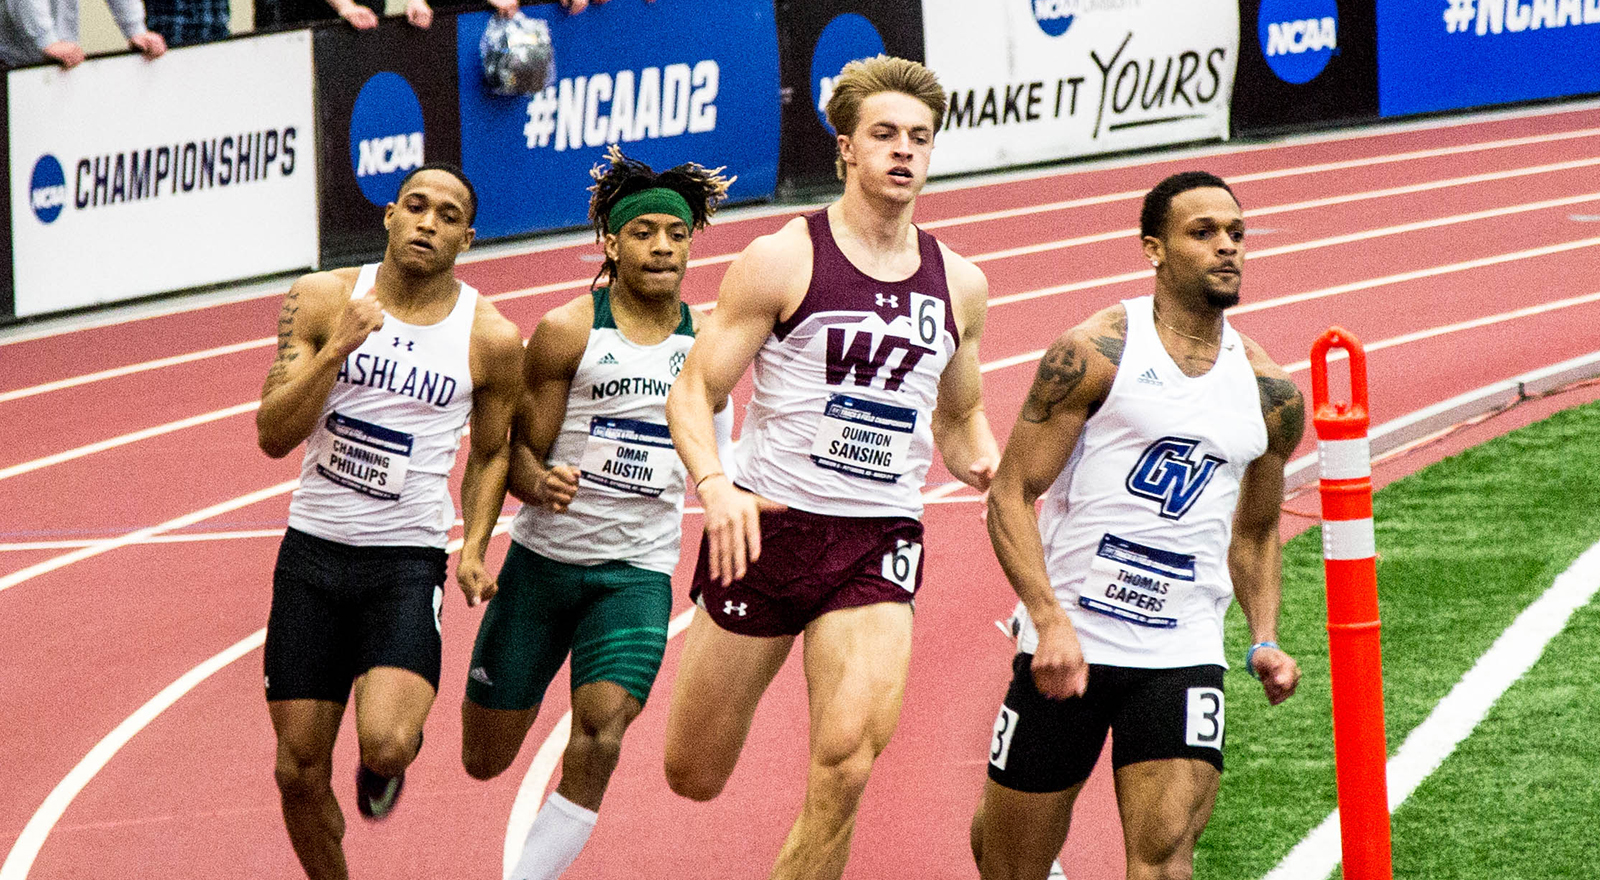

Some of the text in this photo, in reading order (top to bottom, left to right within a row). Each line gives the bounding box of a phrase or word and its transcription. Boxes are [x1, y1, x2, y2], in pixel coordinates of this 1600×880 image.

[1266, 17, 1338, 56] NCAA
[945, 31, 1226, 139] MAKE IT YOURS
[524, 60, 720, 151] #NCAAD2
[75, 127, 297, 210] CHAMPIONSHIPS
[357, 131, 425, 177] NCAA
[918, 298, 937, 345] 6
[336, 353, 457, 407] ASHLAND
[591, 377, 672, 400] NORTHW
[333, 440, 391, 469] CHANNING
[616, 446, 649, 462] OMAR
[829, 440, 893, 468] SANSING
[841, 426, 892, 448] QUINTON
[329, 454, 388, 486] PHILLIPS
[602, 460, 653, 482] AUSTIN
[1125, 435, 1229, 521] GV
[891, 541, 913, 583] 6
[1104, 583, 1166, 613] CAPERS
[1116, 569, 1170, 596] THOMAS
[991, 710, 1009, 762] 3
[1197, 692, 1220, 742] 3
